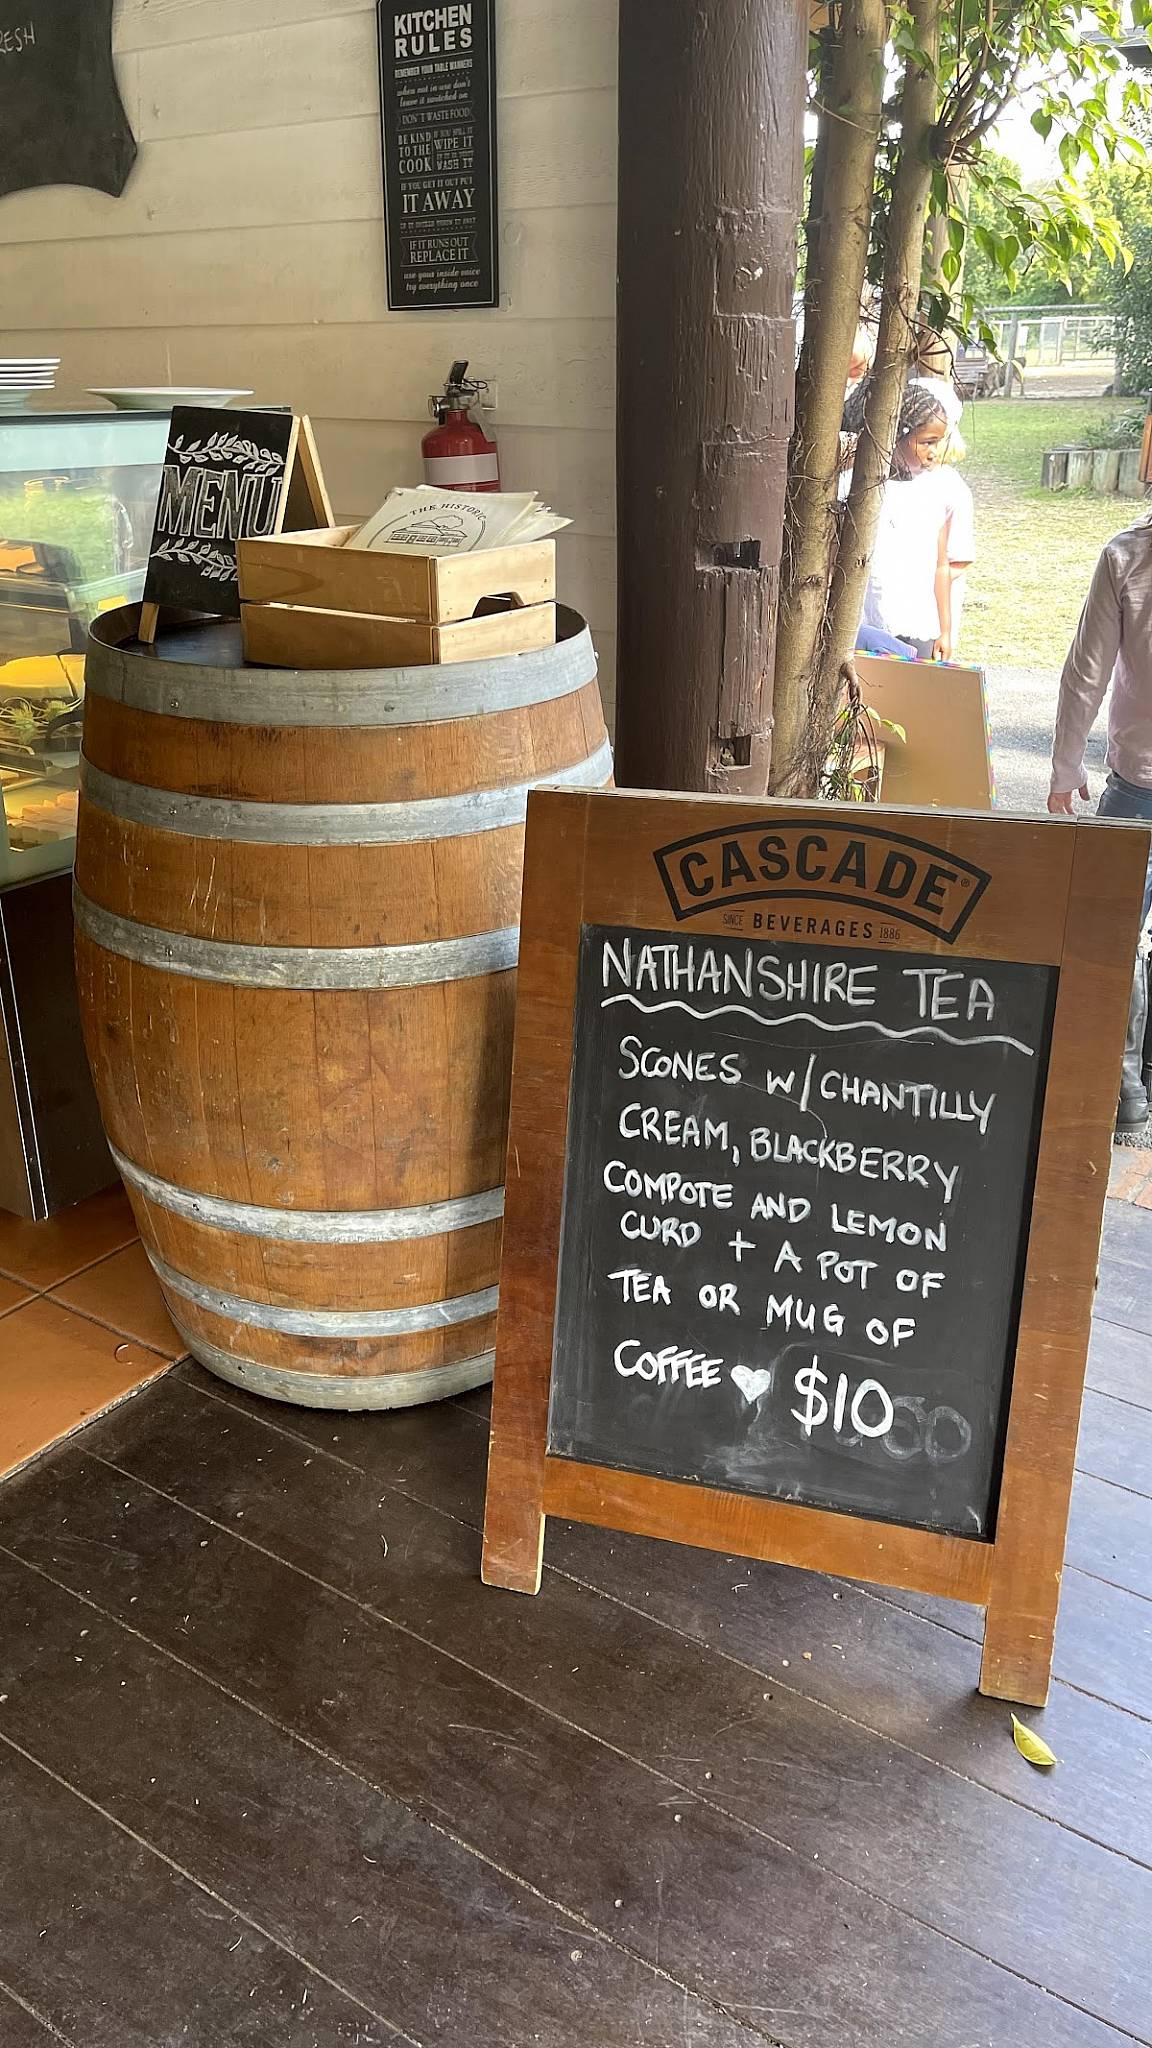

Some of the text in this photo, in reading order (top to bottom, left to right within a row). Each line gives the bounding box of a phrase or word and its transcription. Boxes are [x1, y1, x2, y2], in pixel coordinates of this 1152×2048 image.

[394, 3, 472, 36] KITCHEN
[395, 27, 473, 58] RULES
[427, 110, 449, 122] WASTE
[450, 107, 470, 118] FOOD
[398, 132, 431, 145] BE KIND
[399, 146, 411, 158] TO
[413, 144, 431, 156] THE
[434, 136, 474, 150] WIPE IT
[399, 157, 432, 174] COOK
[437, 158, 473, 171] WASH IT
[423, 180, 436, 189] GET
[437, 179, 444, 187] IT
[445, 178, 458, 186] OUT
[460, 176, 473, 185] PUT
[402, 188, 476, 213] IT AWAY
[410, 237, 470, 250] IF IT RUNS OUT
[410, 248, 469, 263] REPLACE IT
[406, 278, 479, 294] try everything once
[418, 271, 434, 282] your
[436, 266, 460, 277] inside
[460, 268, 480, 277] voice
[157, 464, 283, 541] MENU
[409, 503, 487, 521] THE HISTORIC
[679, 835, 958, 915] CASCADE
[722, 912, 900, 941] SINCE BEVERAGES 1886
[602, 937, 995, 1022] NATHANSHIRE TEA
[617, 1035, 742, 1085] SCONES
[618, 1102, 960, 1204] CREAM, BLACKBERRY
[603, 1160, 947, 1252] COMPOTE AND LEMON
[620, 1210, 946, 1298] CURD + A POT OF
[607, 1267, 915, 1348] TEA OR MUG OF
[613, 1339, 724, 1389] COFFEE
[790, 1354, 895, 1437] $10
